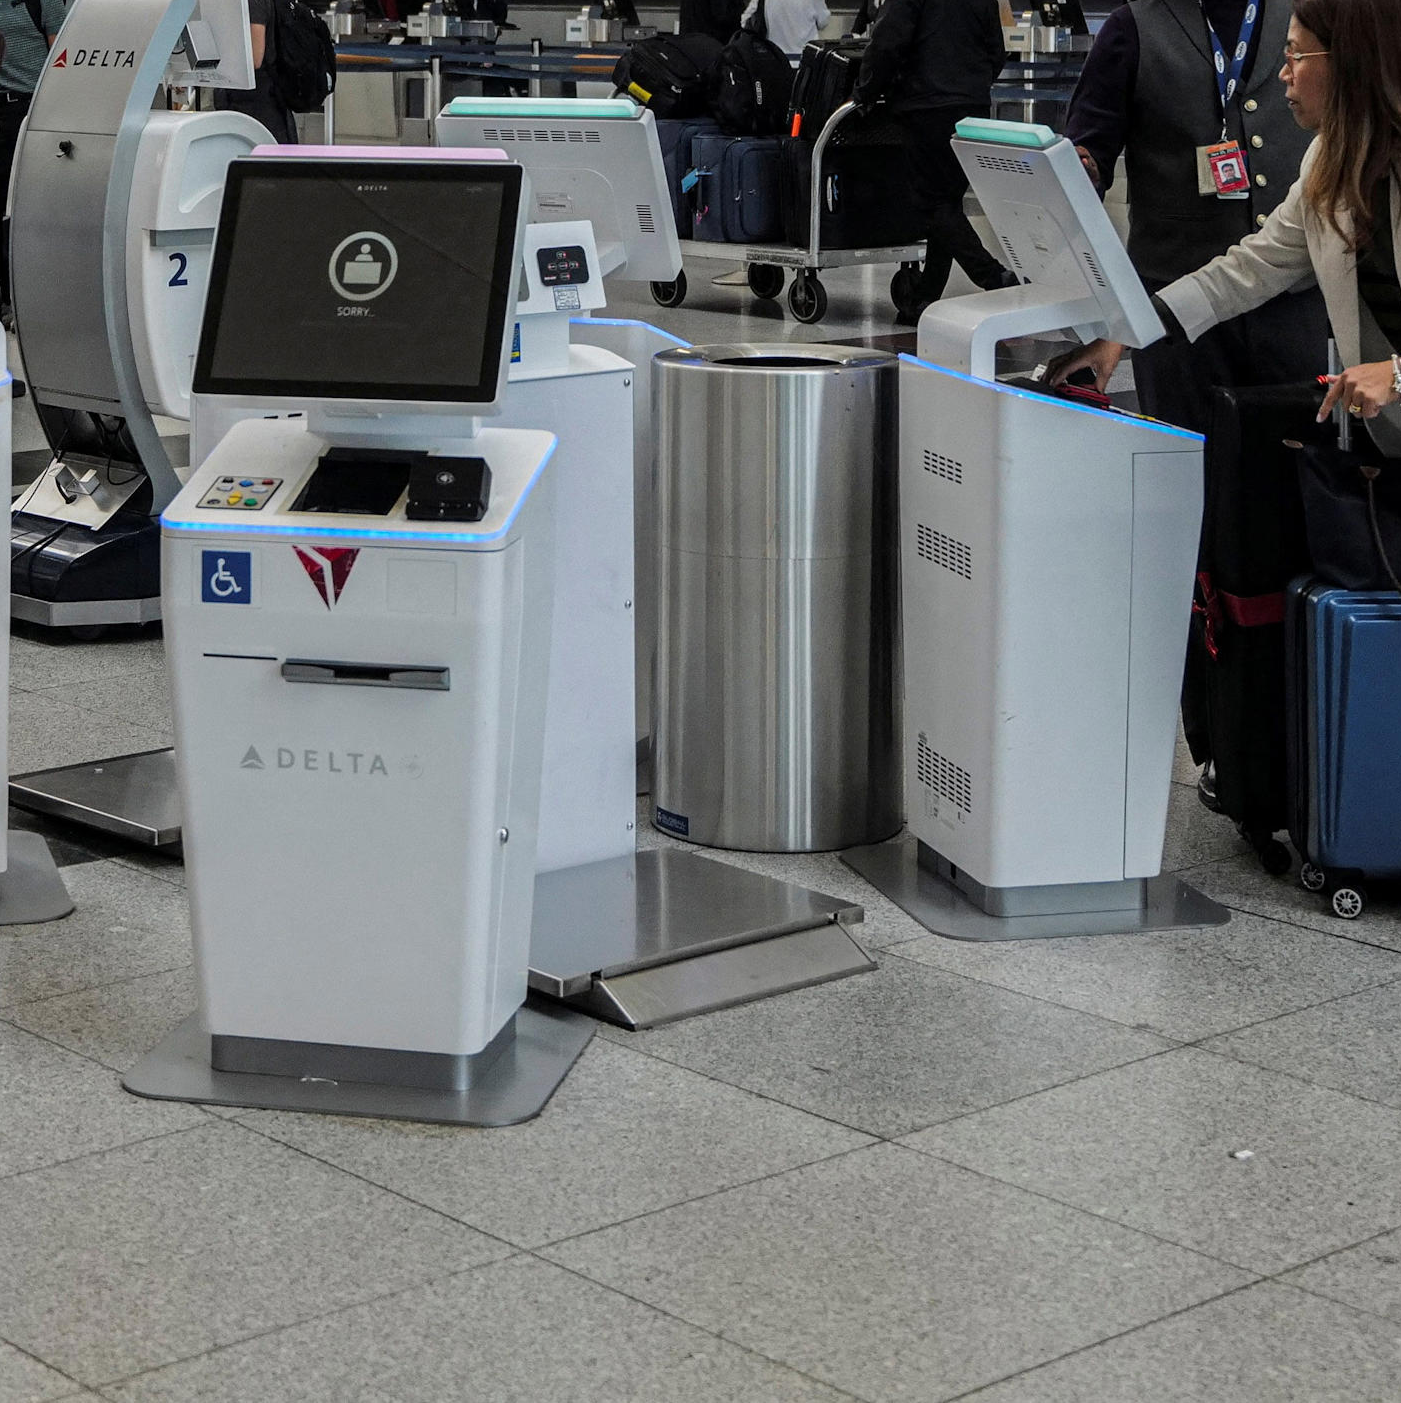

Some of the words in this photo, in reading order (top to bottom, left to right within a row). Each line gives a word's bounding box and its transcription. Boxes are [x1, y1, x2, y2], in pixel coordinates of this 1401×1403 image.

[74, 49, 135, 68] DELTA
[169, 253, 187, 287] 2
[277, 748, 388, 776] DELTA
